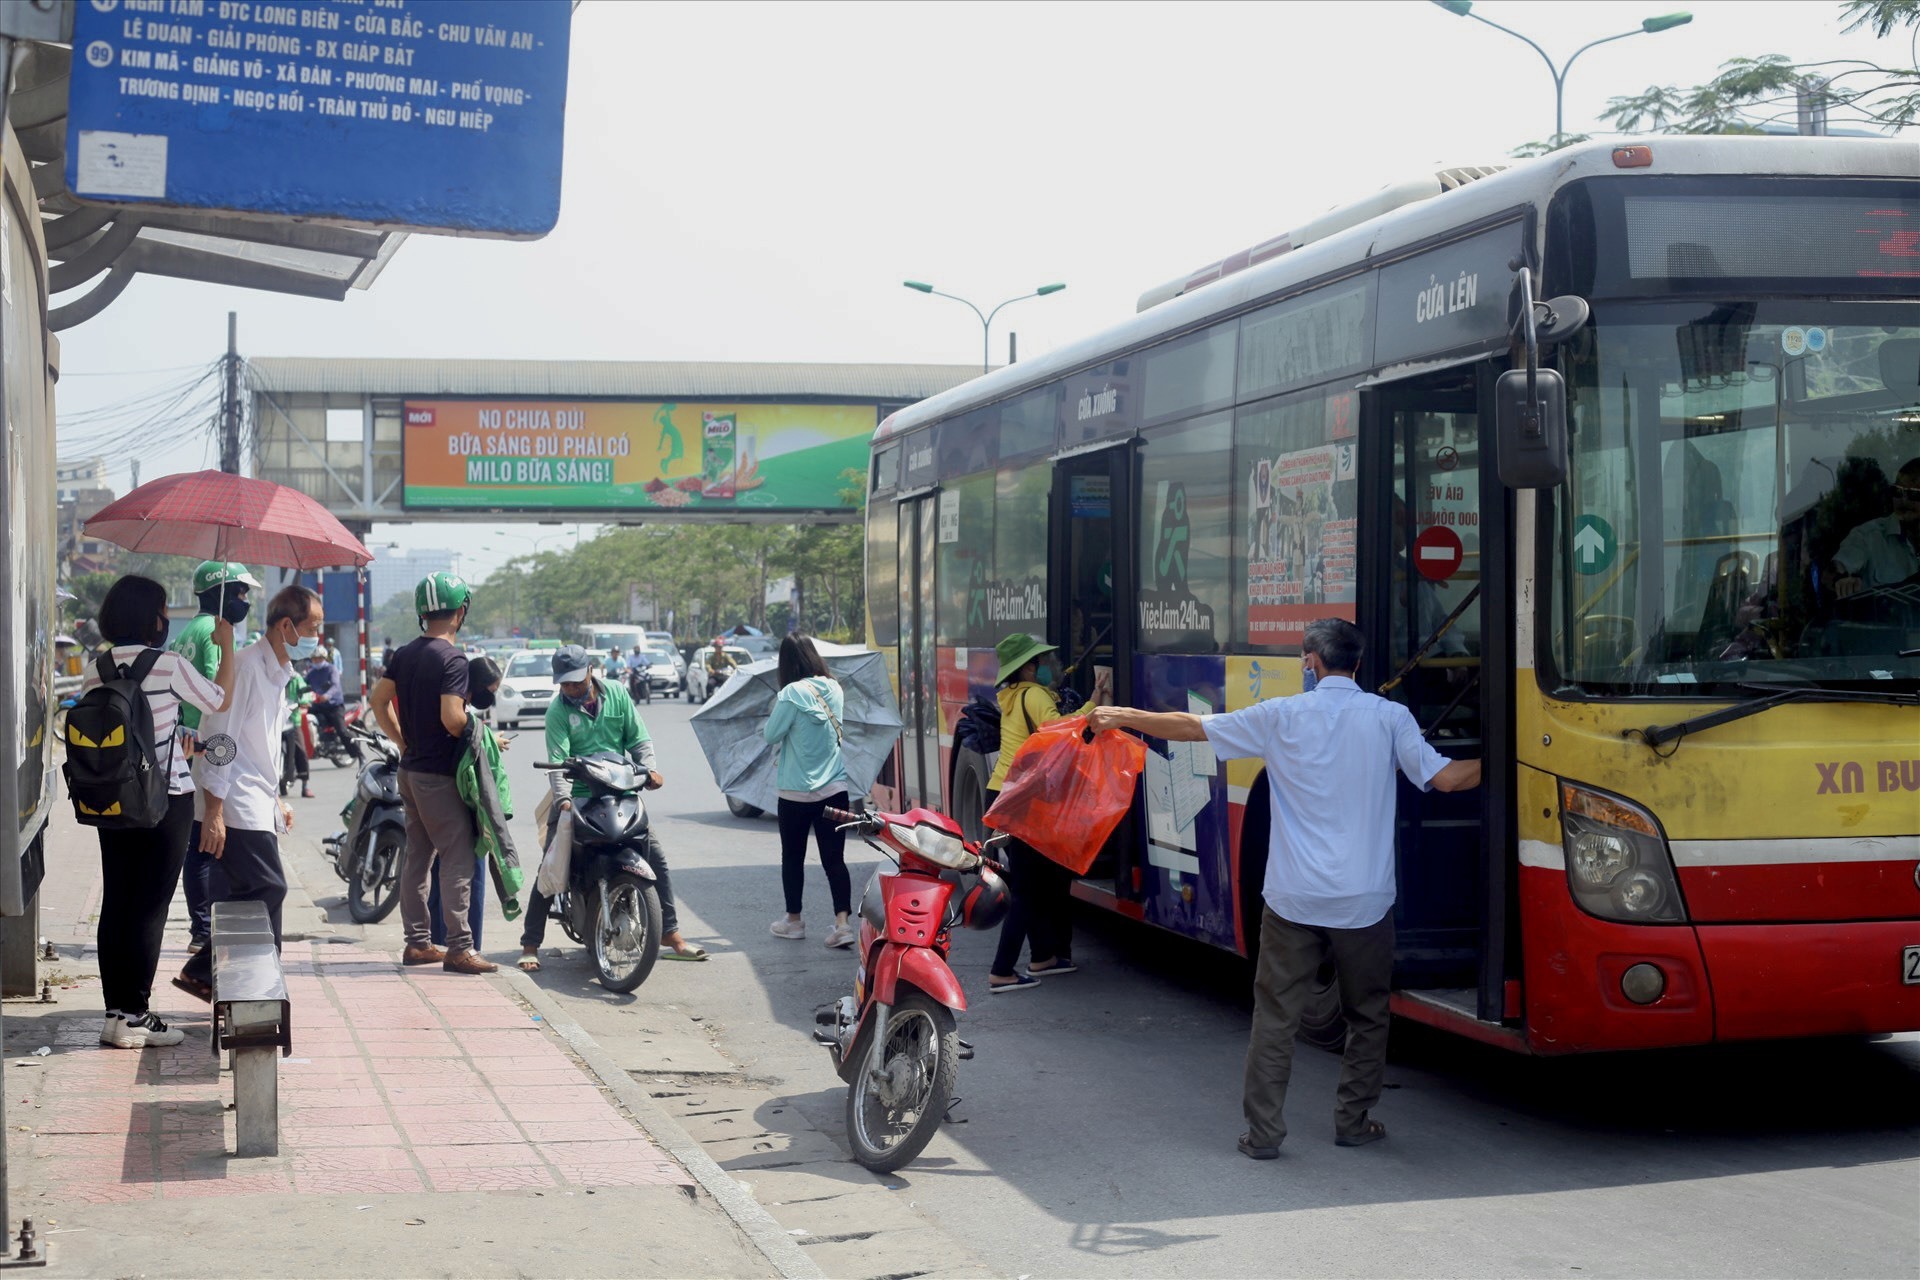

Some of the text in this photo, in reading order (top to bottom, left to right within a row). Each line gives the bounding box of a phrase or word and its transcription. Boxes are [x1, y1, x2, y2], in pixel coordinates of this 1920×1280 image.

[219, 1, 251, 21] ĐTC
[254, 5, 297, 26] LONG
[301, 7, 340, 30] BIÊN
[355, 9, 386, 35] CỬA
[391, 12, 424, 38] BẮC
[438, 23, 470, 43] CHU
[475, 24, 507, 48] VĂN
[510, 31, 534, 50] AN
[91, 46, 110, 62] 99
[123, 17, 142, 39] LÊ
[208, 24, 242, 50] GIẢI
[316, 39, 338, 60] BX
[342, 40, 380, 63] GIÁP
[384, 43, 415, 67] BÁT
[121, 49, 152, 69] KIM
[154, 50, 180, 72] MÃ
[193, 52, 240, 77] GIẢNG
[243, 59, 263, 79] VÕ
[276, 62, 297, 83] XÃ
[301, 65, 332, 86] ĐÀN
[345, 71, 405, 93] PHƯƠNG
[409, 78, 438, 97] MAI
[451, 79, 483, 101] PHỐ
[485, 85, 524, 107] VỌNG
[119, 77, 179, 101] TRƯƠNG
[182, 83, 219, 106] ĐỊNH
[233, 89, 275, 112] NGỌC
[360, 96, 388, 120] THỦ
[1416, 271, 1477, 323] CỬA LÊN
[478, 409, 502, 429] NO
[506, 408, 551, 430] CHƯA
[1333, 396, 1350, 425] 32
[448, 432, 482, 456] BỮA
[486, 431, 531, 456] SÁNG
[607, 431, 630, 456] CÓ
[707, 424, 730, 436] MILO
[468, 457, 610, 483] MILO BỮA SÁNG!
